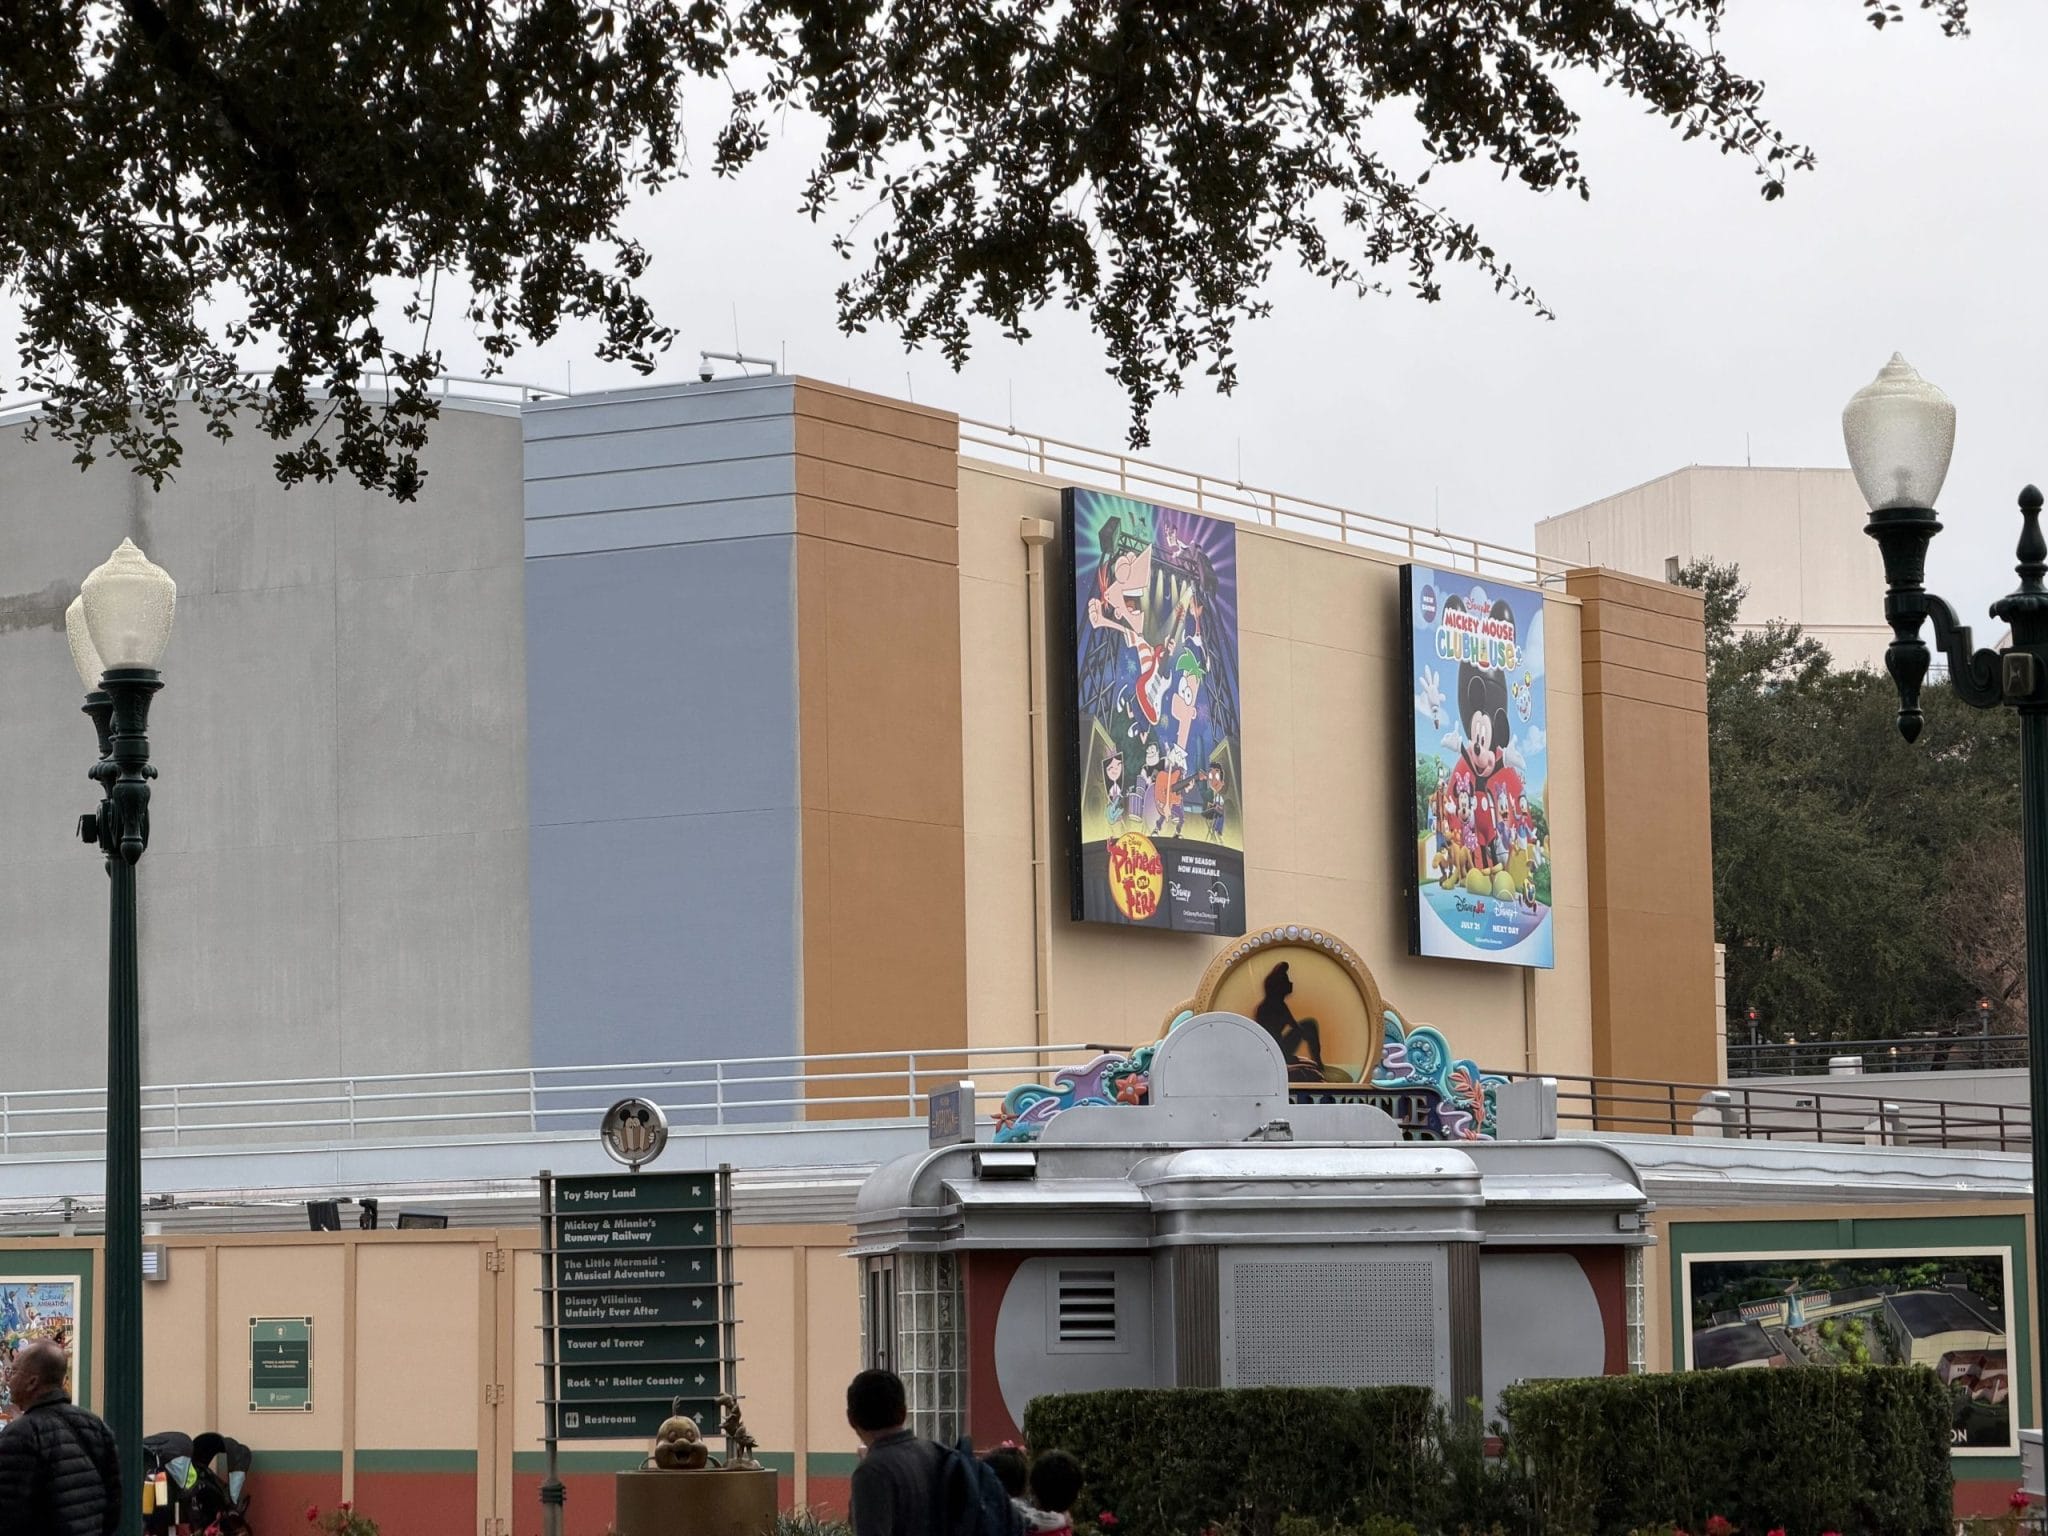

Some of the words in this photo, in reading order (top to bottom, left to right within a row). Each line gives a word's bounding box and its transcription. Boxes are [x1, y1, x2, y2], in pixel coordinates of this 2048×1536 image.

[1444, 610, 1479, 635] MICKEY
[1481, 619, 1514, 642] MOUSE
[1195, 858, 1216, 866] SEASON
[1192, 867, 1220, 877] AVAILABLE
[1169, 881, 1191, 902] Disney
[1453, 895, 1476, 918] Disney
[1492, 925, 1507, 933] NEXT
[1508, 927, 1519, 935] DAY
[564, 1191, 581, 1201] Toy
[584, 1189, 610, 1200] Story
[612, 1188, 636, 1198] Land
[565, 1220, 599, 1231] Mickey
[603, 1220, 610, 1228] &
[614, 1219, 656, 1228] Minnie's
[565, 1233, 609, 1243] Runaway
[612, 1232, 651, 1242] Railway
[565, 1260, 583, 1268] The
[586, 1259, 610, 1268] Little
[614, 1257, 658, 1266] Mermaid
[565, 1272, 572, 1280] A
[575, 1270, 611, 1280] Musical
[614, 1269, 665, 1278] Adventure
[565, 1297, 598, 1307] Disney
[601, 1296, 641, 1305] Villains:
[566, 1307, 606, 1318] Unfairly
[609, 1307, 630, 1316] Ever
[633, 1306, 659, 1315] After
[567, 1340, 597, 1349] Tower
[600, 1339, 610, 1348] of
[613, 1338, 644, 1348] Terror
[567, 1379, 590, 1387] Rock
[595, 1378, 609, 1387] 'n'
[613, 1377, 643, 1386] Roller
[646, 1376, 684, 1385] Coaster
[585, 1415, 636, 1424] Restrooms
